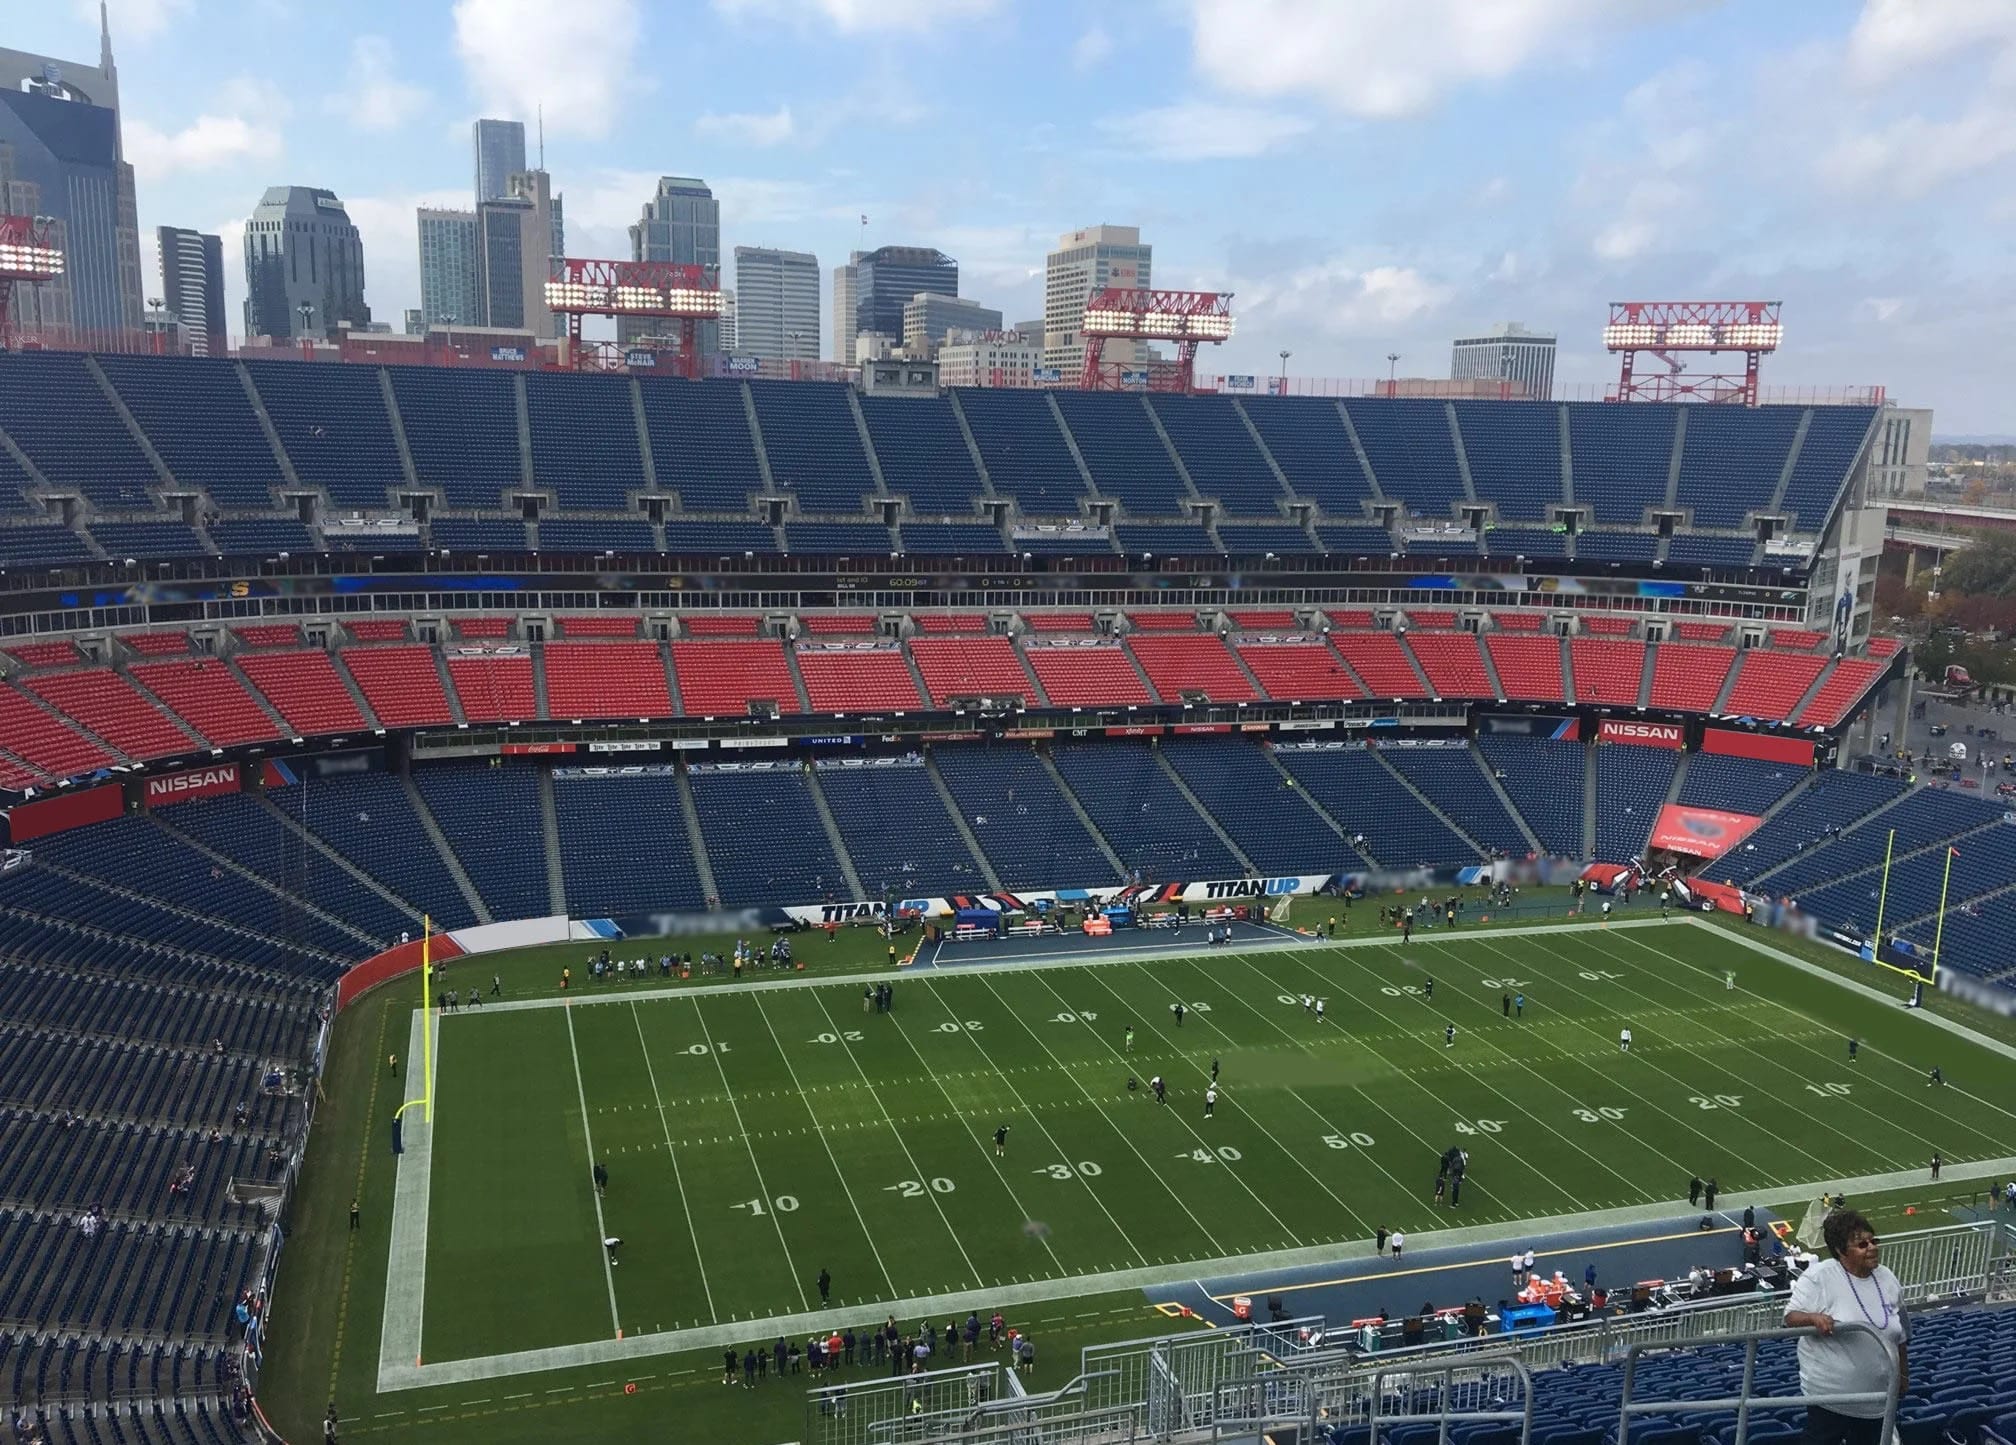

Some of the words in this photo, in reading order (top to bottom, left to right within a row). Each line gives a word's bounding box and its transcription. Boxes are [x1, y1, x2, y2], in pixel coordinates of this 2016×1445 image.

[1072, 729, 1088, 737] CMT
[1125, 728, 1144, 736] xfinity
[1603, 723, 1678, 740] NISSAN
[882, 735, 902, 743] FedEx
[150, 768, 235, 795] NISSAN
[1667, 844, 1702, 855] NISSAN
